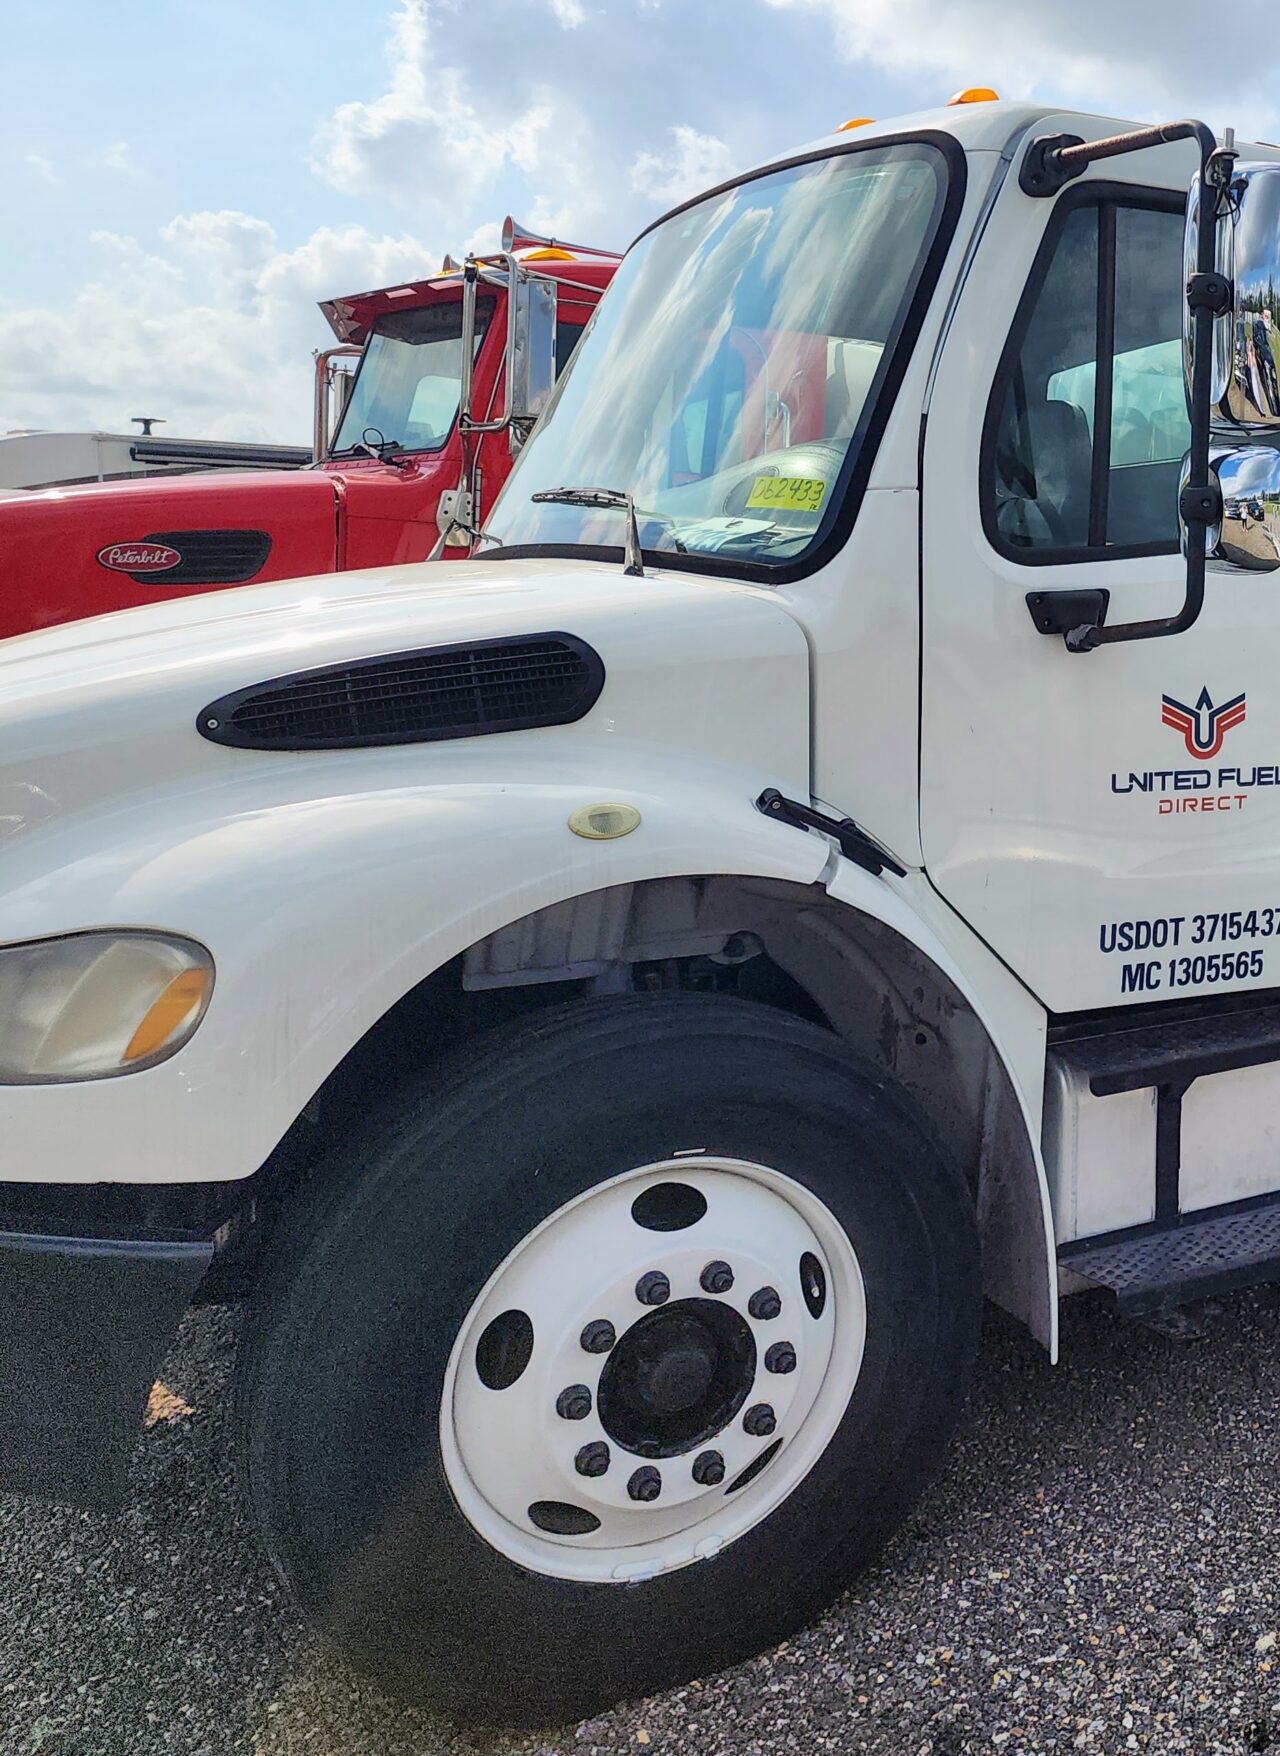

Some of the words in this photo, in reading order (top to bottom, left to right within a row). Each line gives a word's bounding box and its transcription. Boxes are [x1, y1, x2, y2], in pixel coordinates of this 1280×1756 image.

[109, 549, 173, 564] Peterbilt
[1111, 768, 1211, 794] UNITED
[1158, 795, 1247, 814] DIRECT
[1100, 917, 1185, 953] USDOT
[1120, 960, 1161, 993] MC
[1168, 949, 1264, 987] 1305565
